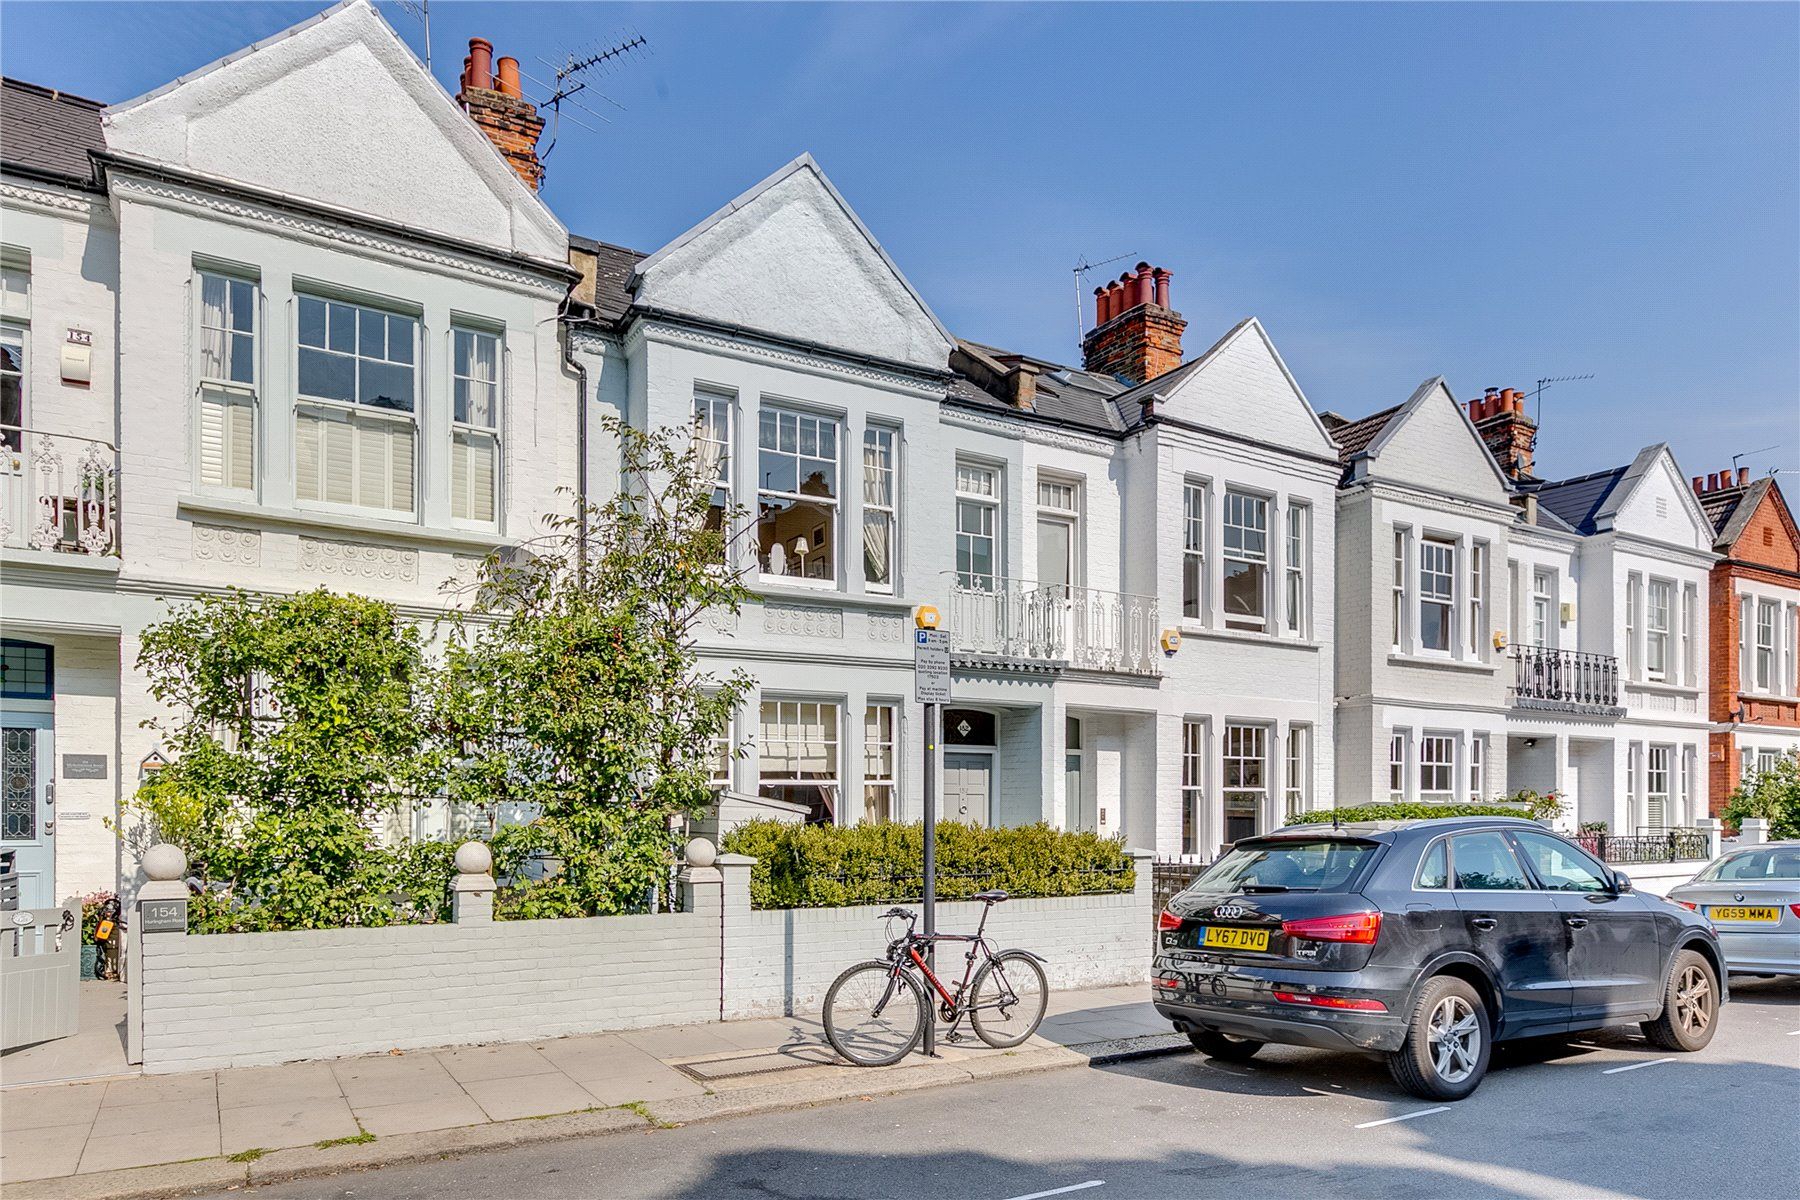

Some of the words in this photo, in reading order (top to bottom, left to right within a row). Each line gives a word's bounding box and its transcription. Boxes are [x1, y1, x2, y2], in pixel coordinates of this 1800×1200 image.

[70, 331, 90, 342] 154
[151, 906, 178, 918] 154
[1715, 908, 1746, 918] YG59
[1749, 908, 1773, 919] MMA
[1206, 929, 1238, 945] LY67
[1241, 931, 1266, 947] DVO
